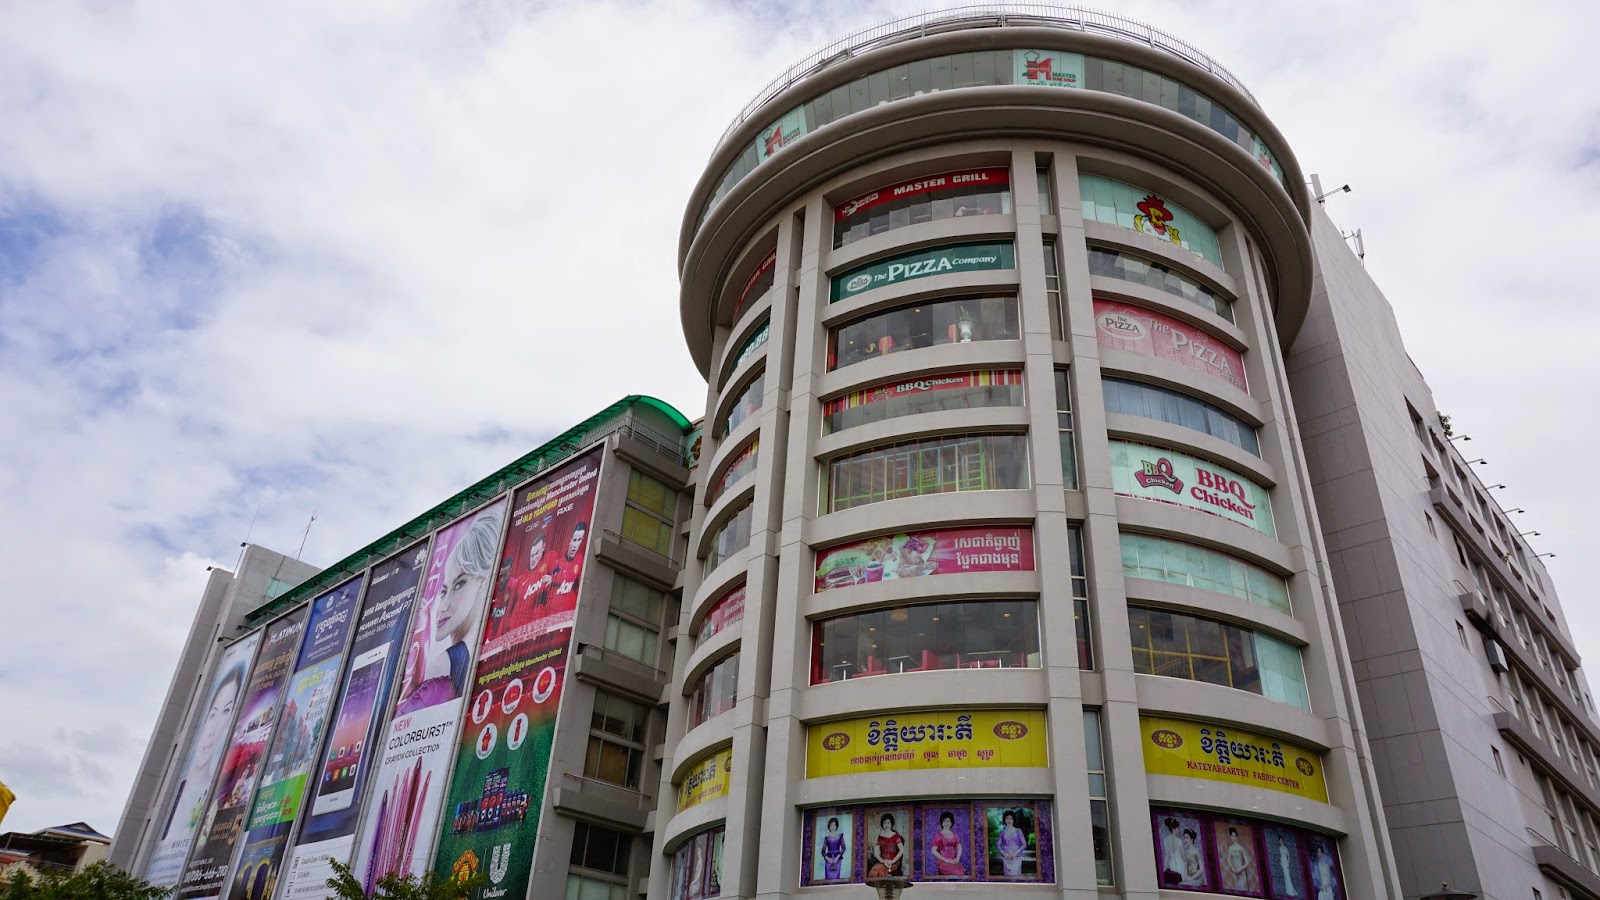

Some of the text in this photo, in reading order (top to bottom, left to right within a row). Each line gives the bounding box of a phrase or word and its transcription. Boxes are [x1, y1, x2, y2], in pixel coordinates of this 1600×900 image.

[1052, 72, 1077, 80] MASTER
[893, 172, 989, 196] MASTER GRILL
[874, 255, 997, 282] The PIZZA Company
[1105, 317, 1140, 334] PIZZA
[1148, 319, 1234, 376] The PIZZA
[896, 377, 964, 393] BBQ Chicken
[1141, 458, 1178, 484] BBQ
[1145, 477, 1175, 489] Chicken
[1196, 467, 1256, 509] BBQ
[556, 503, 575, 517] AXE
[1190, 486, 1254, 521] Chicken
[269, 621, 303, 645] PLATINUM
[393, 716, 412, 733] NEW
[404, 743, 441, 760] COLLECTION
[1186, 761, 1301, 789] KATEYAREAKTEY FABRIC CENTER
